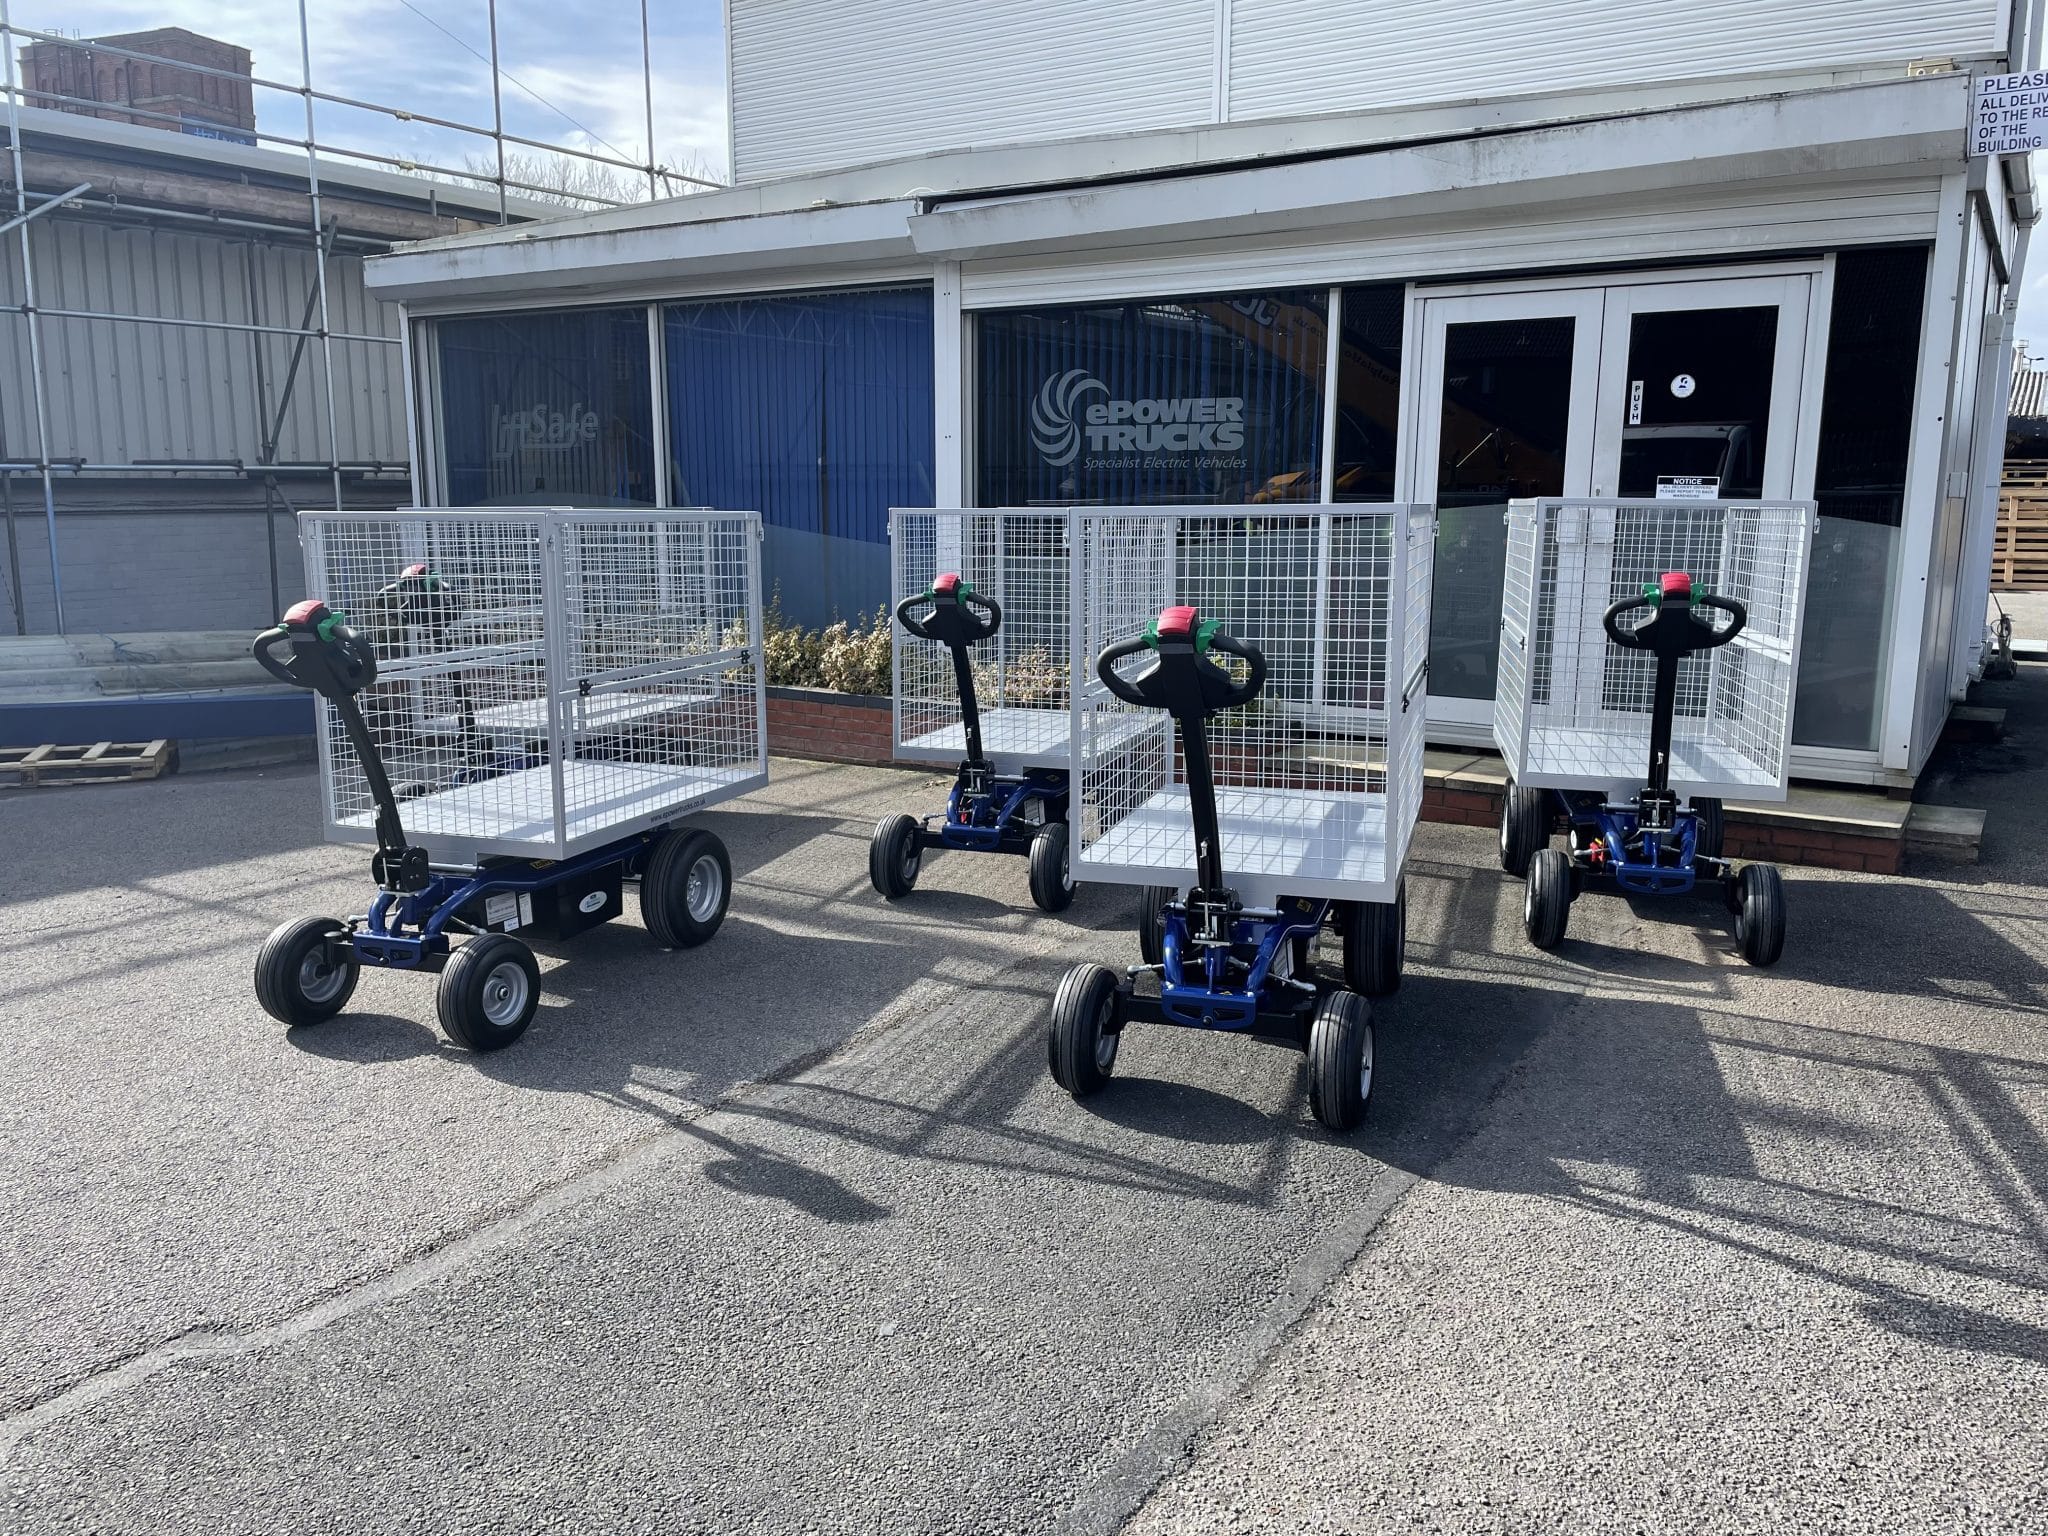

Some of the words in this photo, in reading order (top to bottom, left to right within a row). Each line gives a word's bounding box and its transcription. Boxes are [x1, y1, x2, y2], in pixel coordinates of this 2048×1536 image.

[1980, 97, 2006, 110] ALL
[1980, 112, 1998, 124] TO
[2002, 108, 2028, 122] THE
[1979, 126, 1997, 139] OF
[2001, 123, 2027, 136] THE
[1978, 136, 2042, 153] BUILDING
[1632, 385, 1641, 420] PUSH
[1085, 397, 1244, 425] ePOWER
[1085, 422, 1245, 451] TRUCKS
[1084, 456, 1140, 471] Specialist
[1144, 456, 1190, 469] Electric
[1194, 455, 1248, 469] Vehicles
